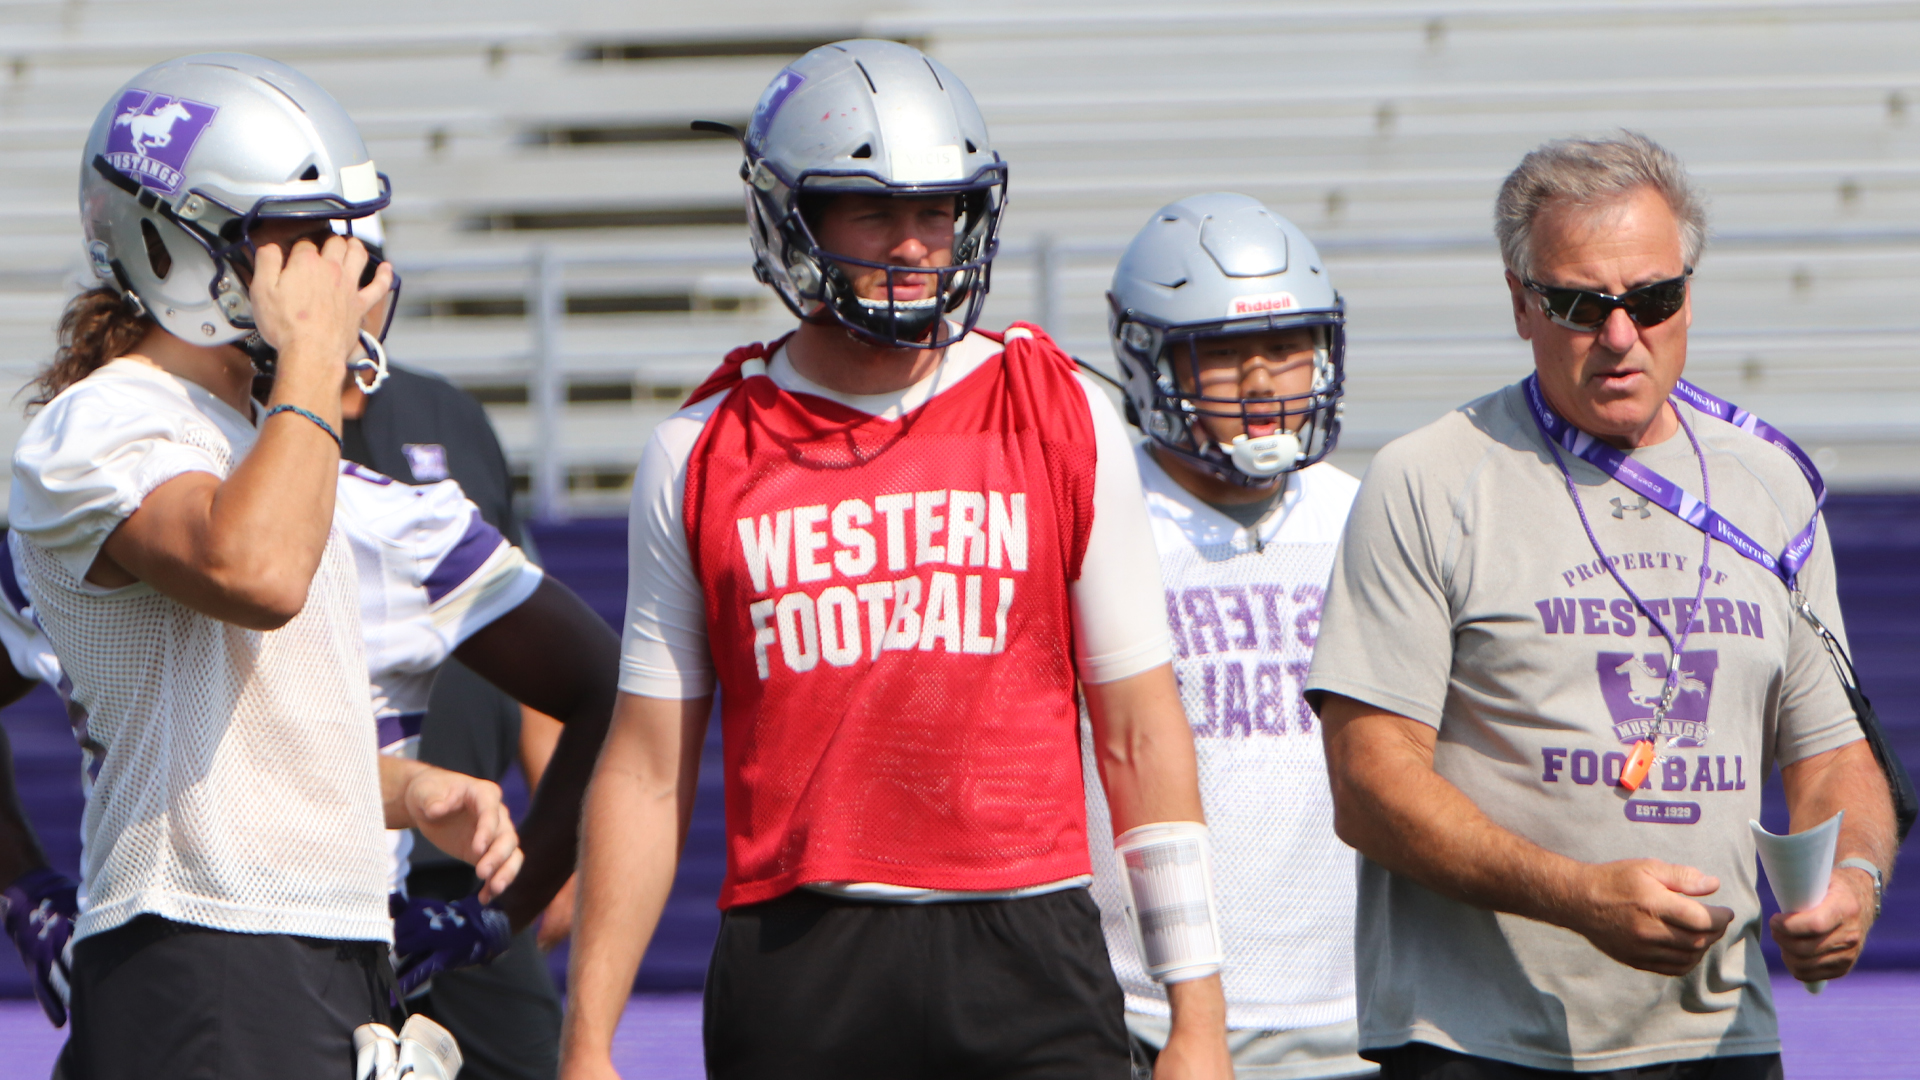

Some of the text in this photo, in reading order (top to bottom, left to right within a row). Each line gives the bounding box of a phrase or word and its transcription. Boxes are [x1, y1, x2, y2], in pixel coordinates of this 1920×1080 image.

[1235, 296, 1291, 313] Riddell
[1676, 380, 1722, 415] Western
[737, 489, 1028, 593] WESTERN
[1717, 519, 1762, 560] Western
[1561, 551, 1729, 588] PROPERTY OF
[750, 571, 1014, 680] FOOTBALL
[1534, 596, 1764, 639] WESTERN
[1541, 747, 1746, 791] FOOBALL
[1635, 804, 1691, 818] EST. 1929
